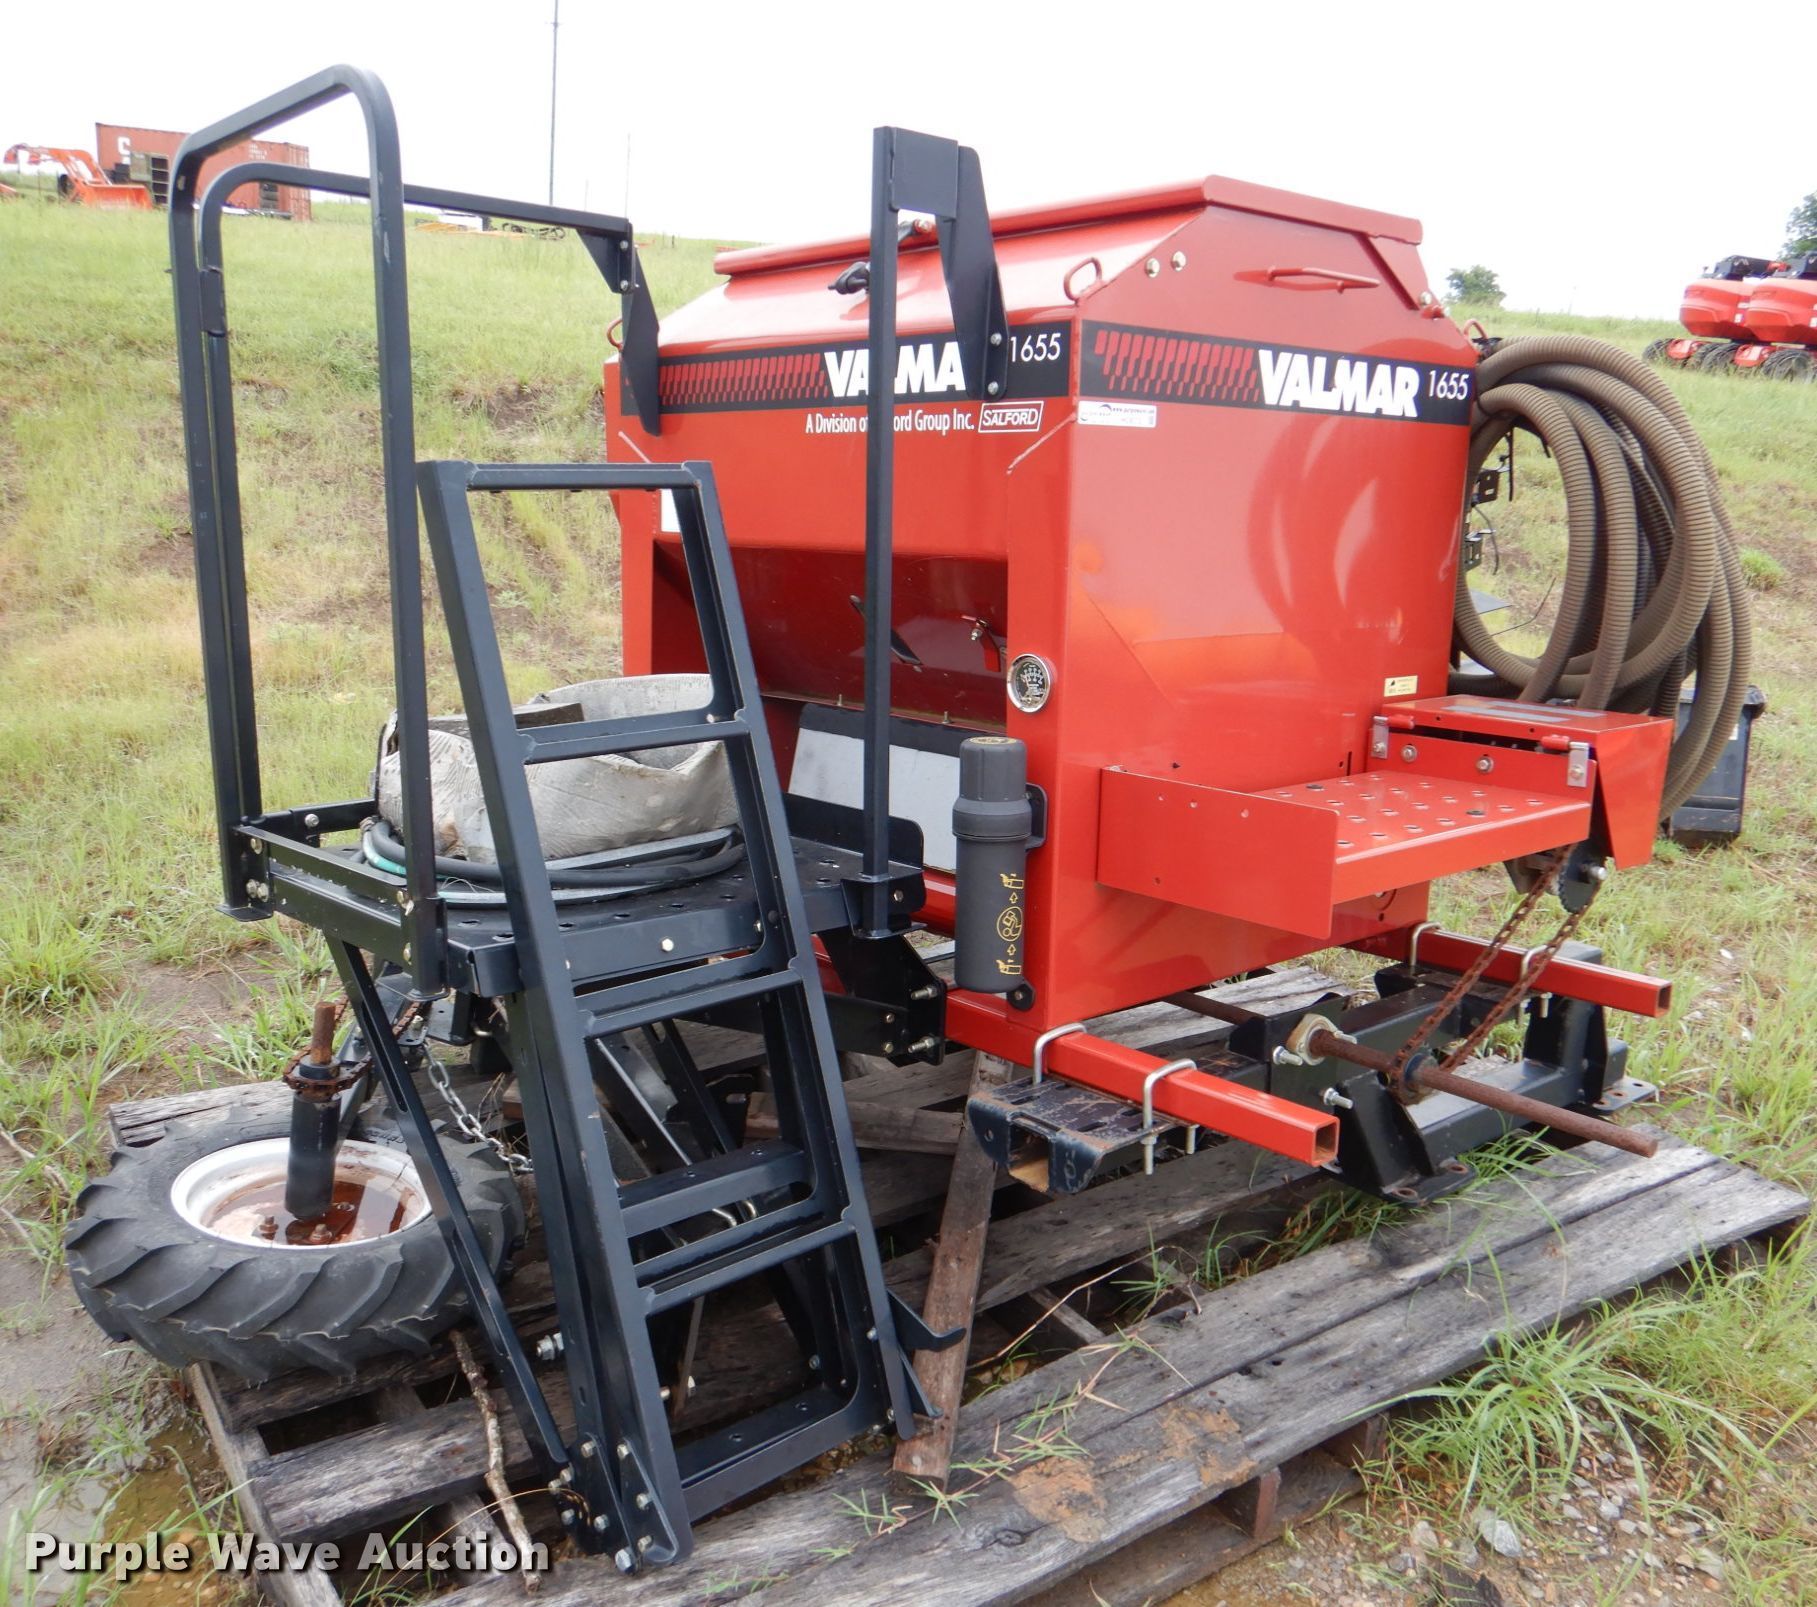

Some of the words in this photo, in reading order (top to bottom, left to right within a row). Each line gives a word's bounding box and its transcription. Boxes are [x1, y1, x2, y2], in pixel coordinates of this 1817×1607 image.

[824, 341, 966, 397] VAMA
[1009, 332, 1062, 363] 1655
[1258, 349, 1420, 418] VALMAR
[1428, 369, 1470, 401] 1655
[805, 413, 814, 434] A
[815, 412, 857, 433] Division
[914, 409, 950, 436] Group
[953, 408, 975, 430] Inc.
[982, 408, 1039, 426] SALFORD
